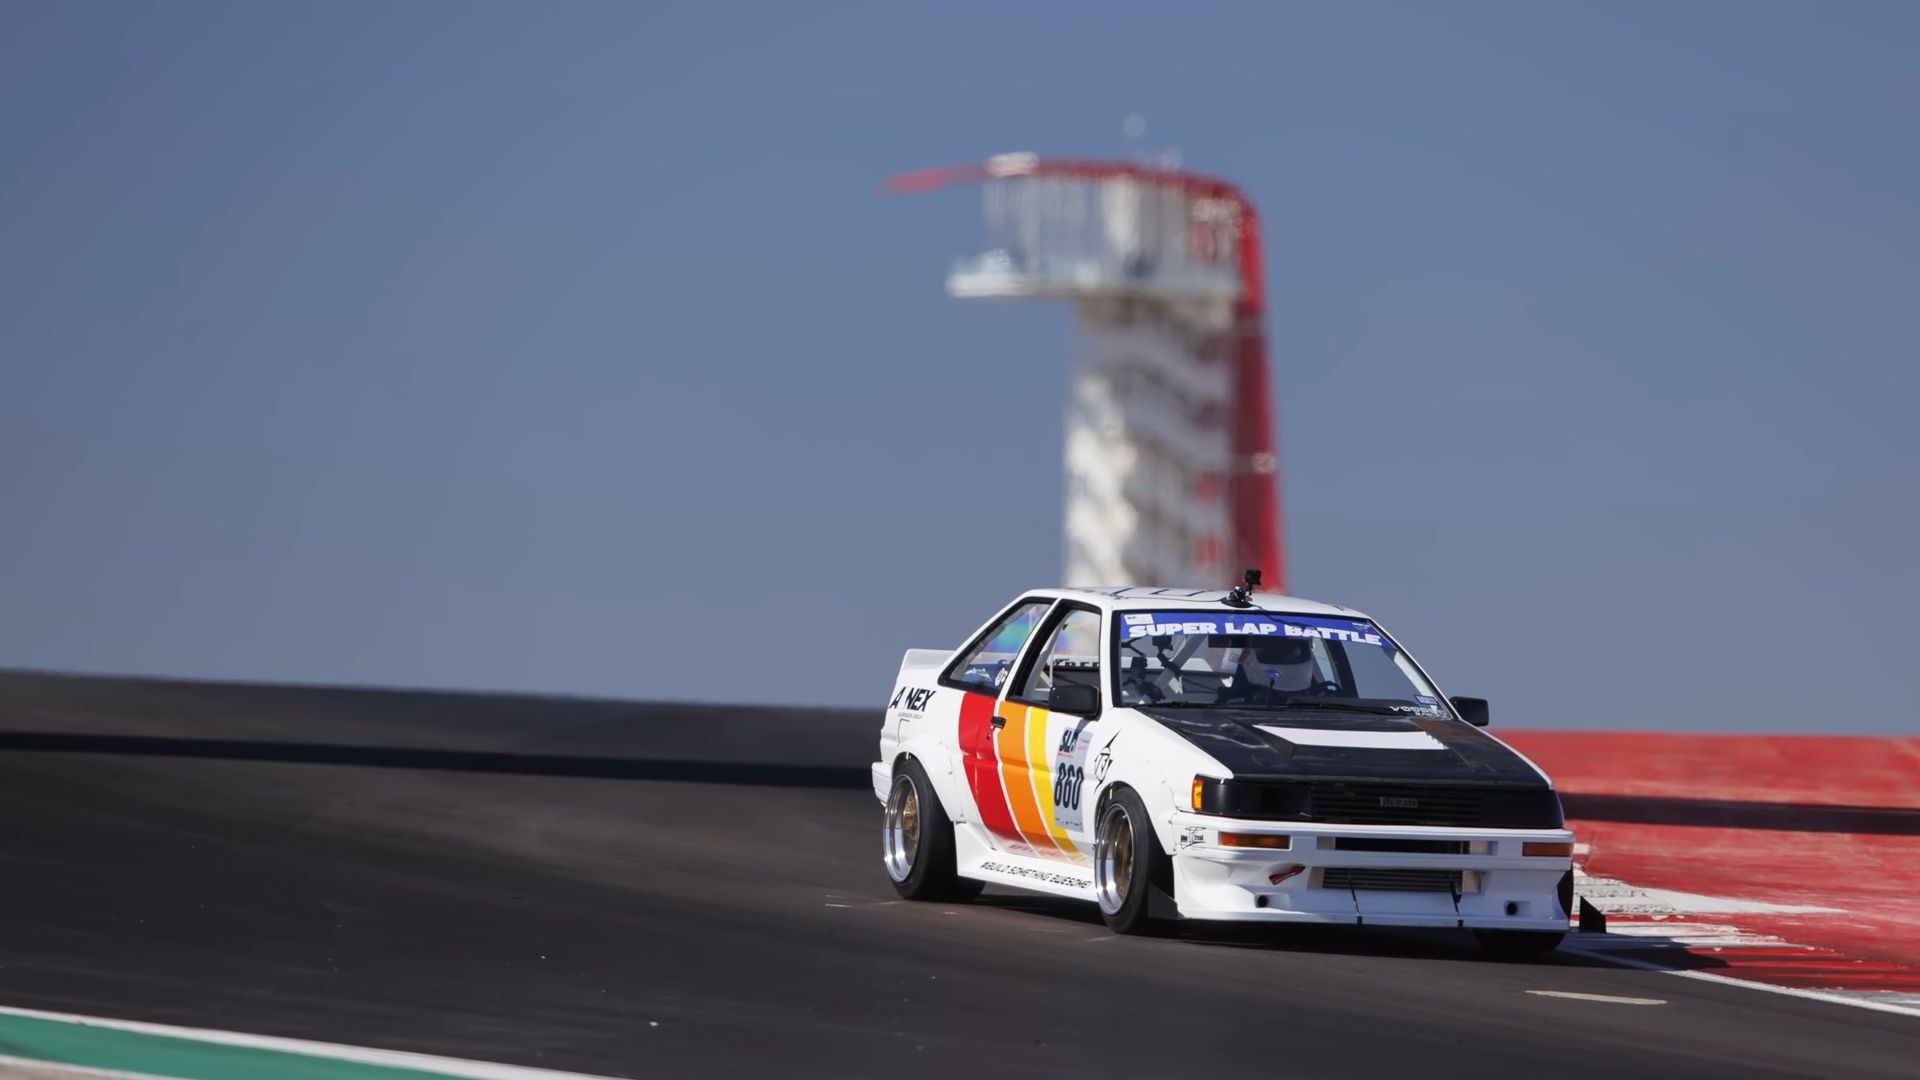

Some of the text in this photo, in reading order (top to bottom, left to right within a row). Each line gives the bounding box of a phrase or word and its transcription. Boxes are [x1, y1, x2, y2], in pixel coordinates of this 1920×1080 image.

[1129, 623, 1217, 638] SUPER
[1225, 622, 1277, 635] LAP
[1284, 625, 1382, 646] BATTLE
[1054, 762, 1084, 810] 860
